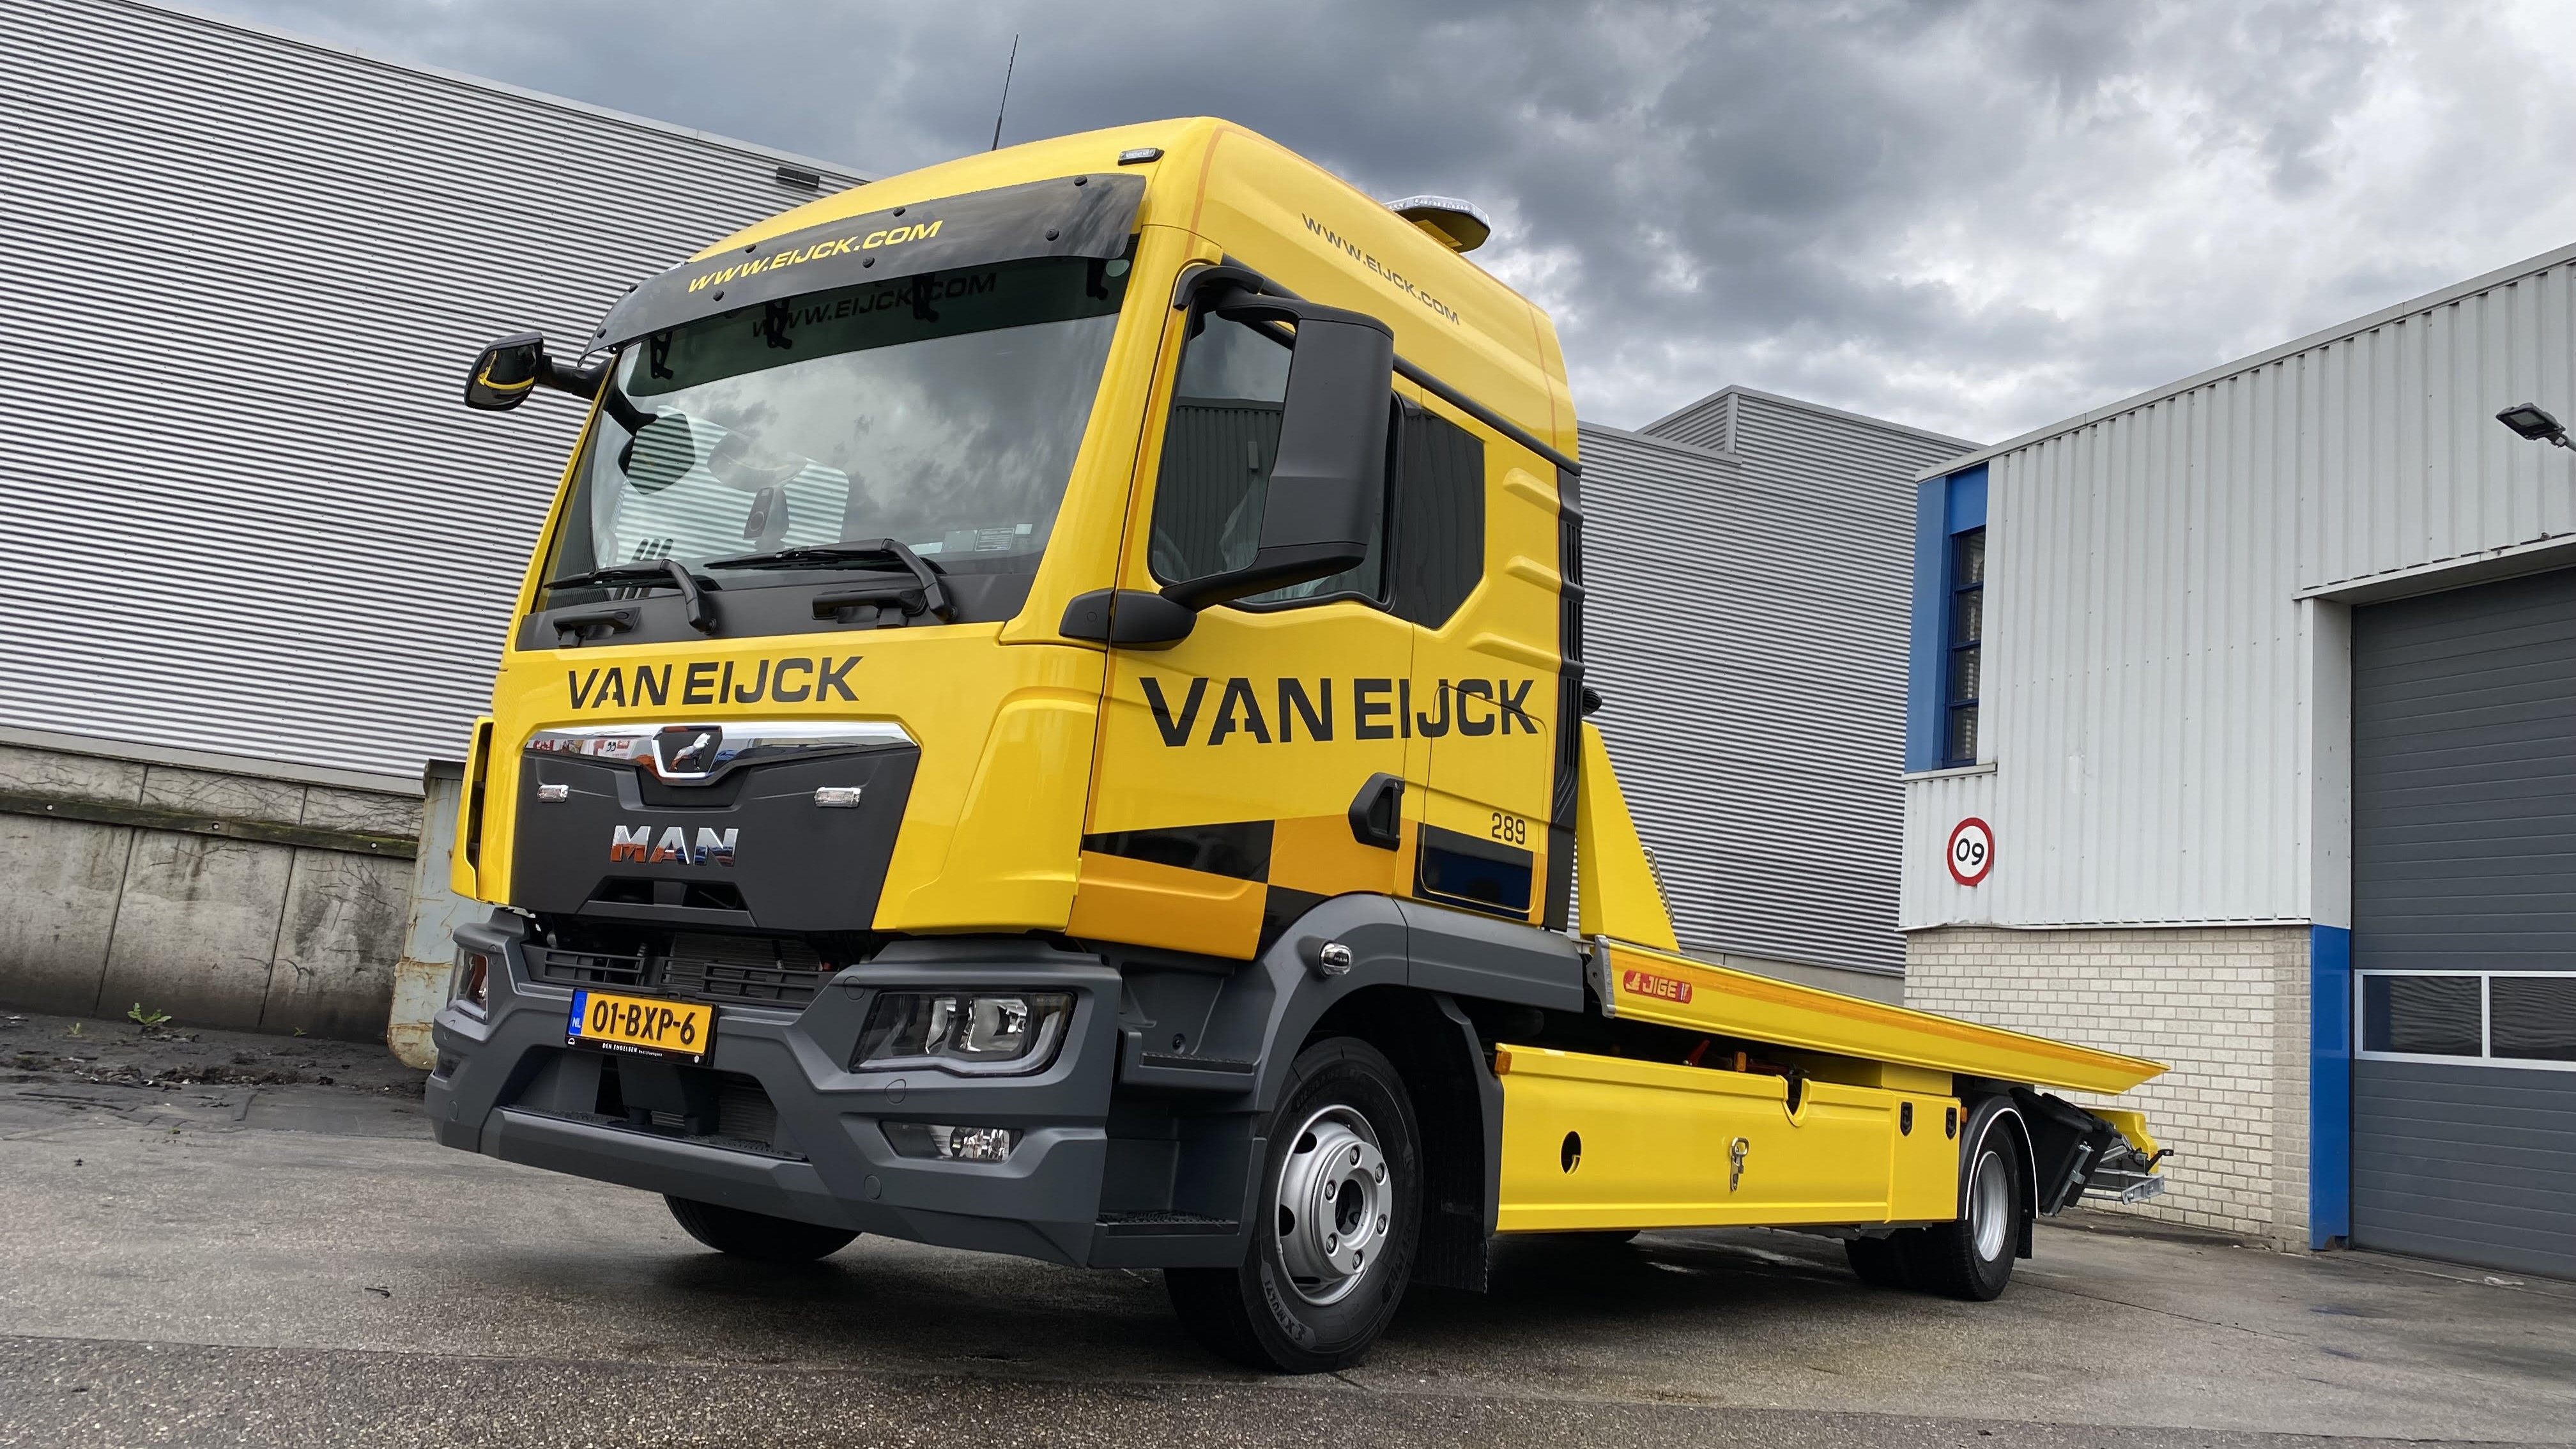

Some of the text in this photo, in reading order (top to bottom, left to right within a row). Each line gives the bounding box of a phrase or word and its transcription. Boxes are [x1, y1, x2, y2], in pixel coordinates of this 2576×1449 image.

[687, 220, 943, 293] WWW.EIJCK.COM
[1301, 213, 1460, 326] WWW.EIJCK.COM
[568, 656, 864, 709] VAN EIJCK
[1138, 677, 1538, 747] VAN EIJCK
[610, 825, 739, 867] MAN
[1492, 812, 1526, 845] 289
[1643, 976, 1677, 998] JIGE
[572, 1017, 581, 1028] NL
[593, 1000, 695, 1045] 01-BXP-6
